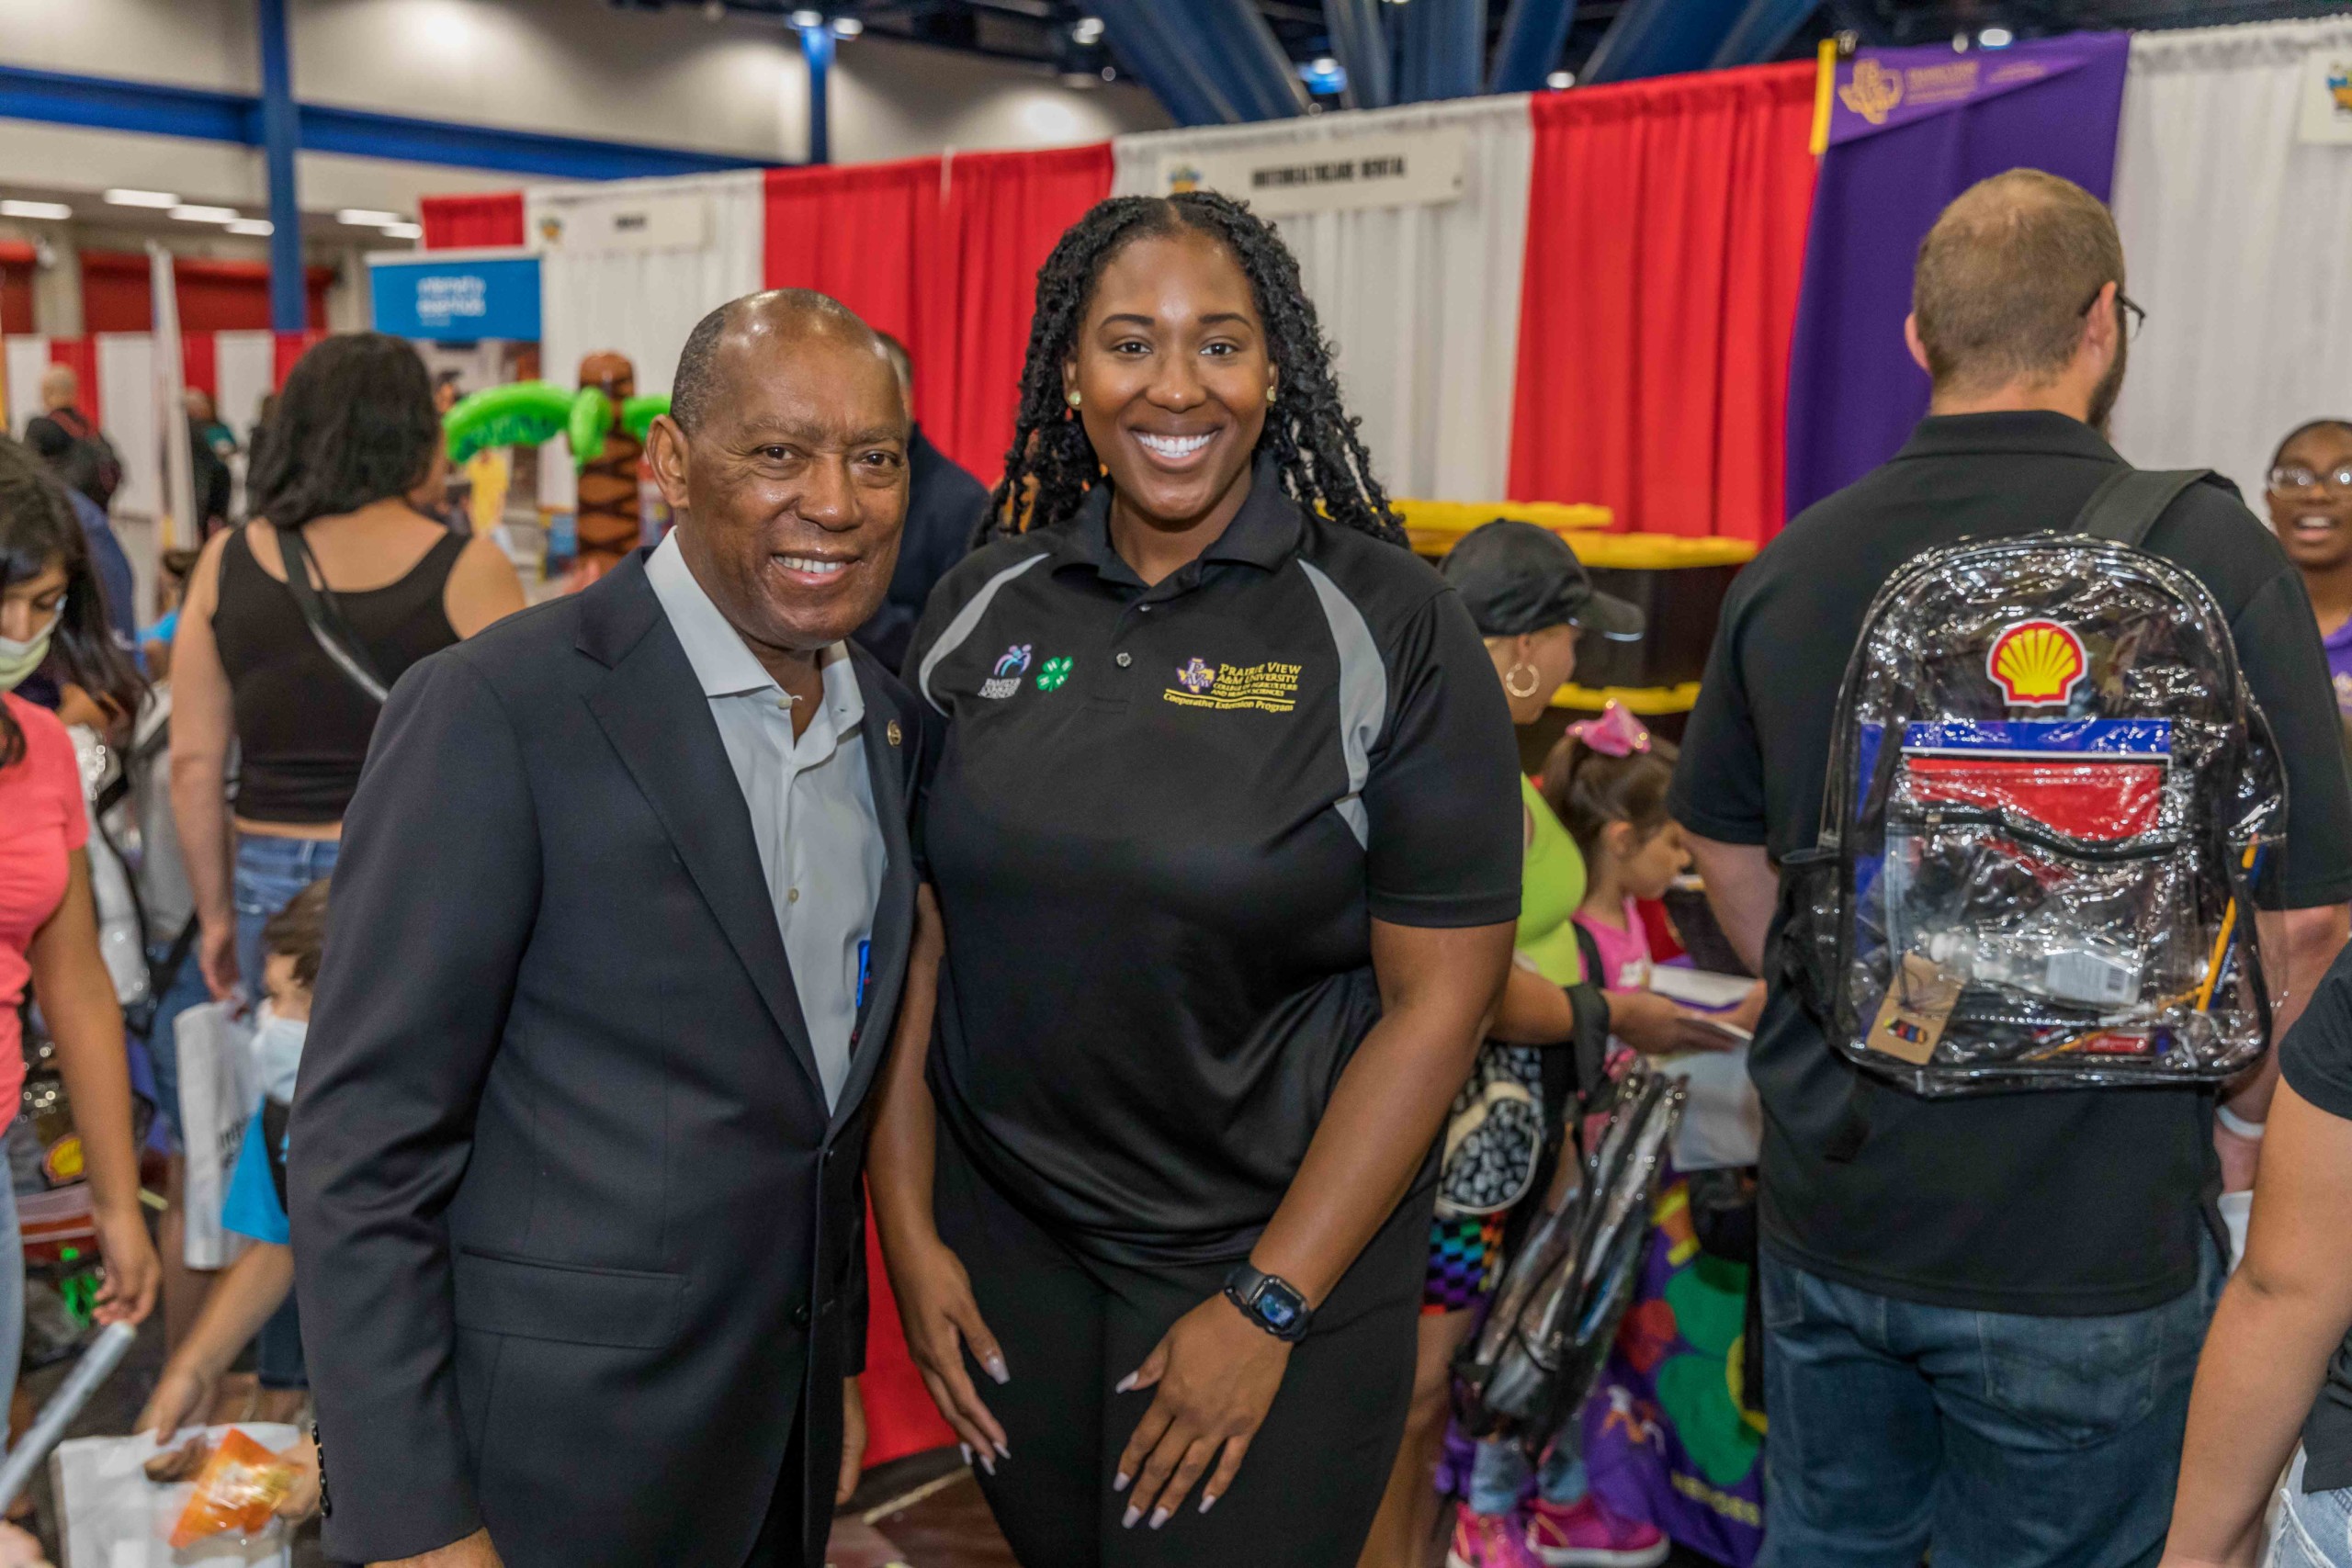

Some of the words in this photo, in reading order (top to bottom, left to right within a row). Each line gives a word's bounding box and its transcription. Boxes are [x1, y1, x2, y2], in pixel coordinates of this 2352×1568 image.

[1218, 663, 1265, 677] PRAIRIE
[1267, 662, 1302, 675] VIEW
[1216, 673, 1244, 685] A&M
[1245, 672, 1298, 684] UNIVERSITY
[1163, 693, 1214, 708] Cooperative
[1215, 700, 1254, 710] Extension
[1255, 700, 1294, 713] Program
